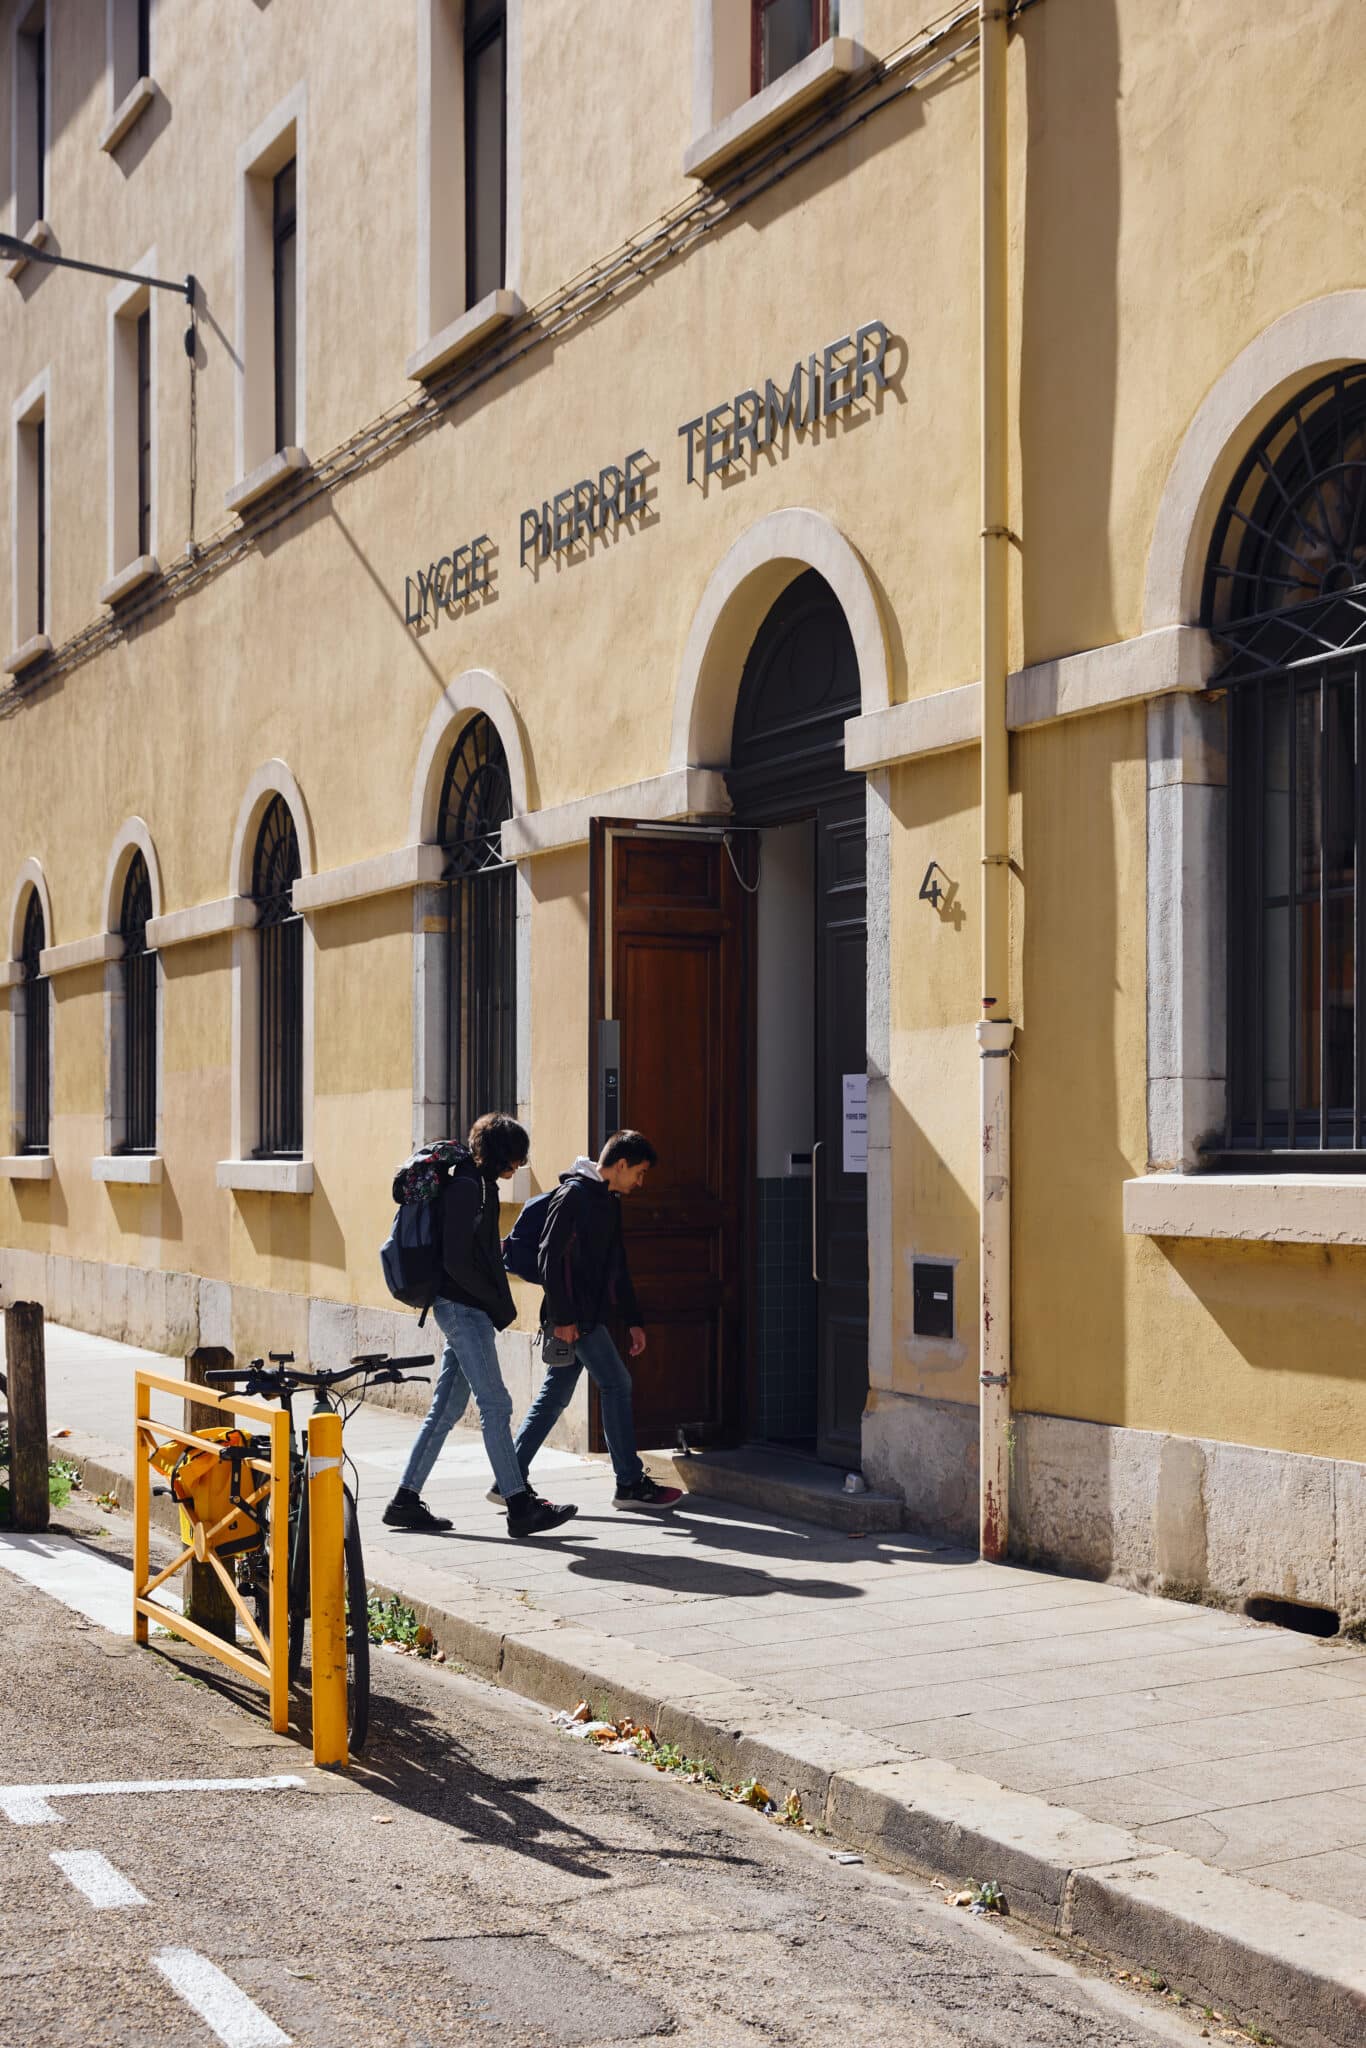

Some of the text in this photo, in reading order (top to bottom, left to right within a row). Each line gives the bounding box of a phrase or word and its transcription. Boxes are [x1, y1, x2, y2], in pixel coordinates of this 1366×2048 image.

[405, 320, 888, 624] LYCEE PIERRE TERMIER
[919, 861, 942, 908] 4
